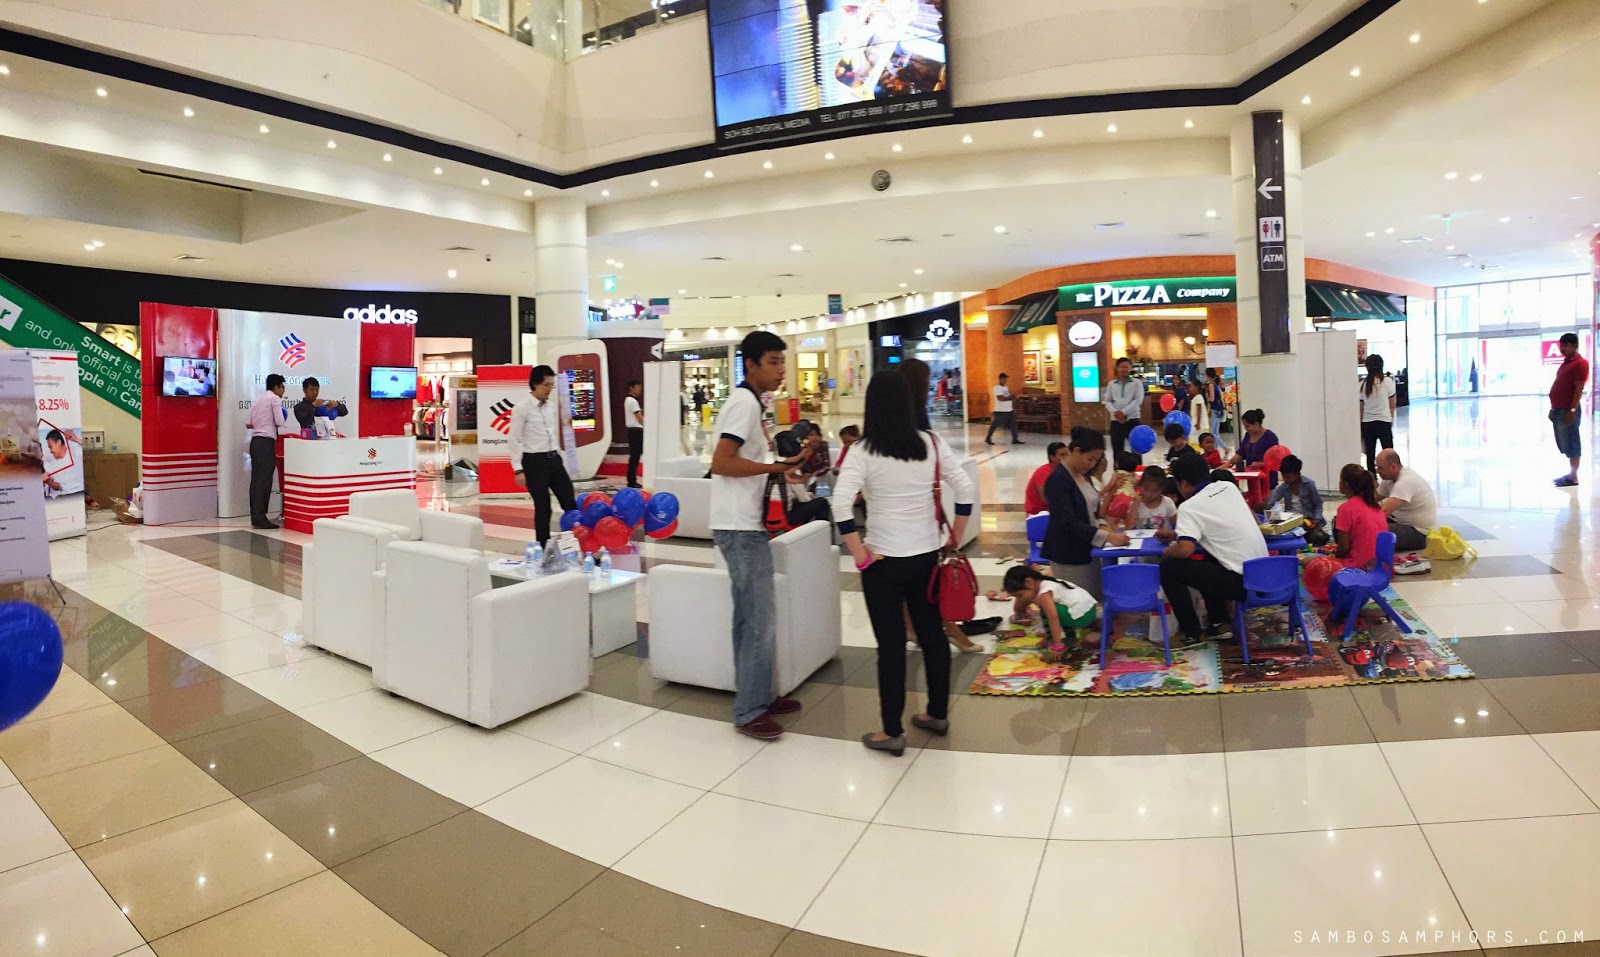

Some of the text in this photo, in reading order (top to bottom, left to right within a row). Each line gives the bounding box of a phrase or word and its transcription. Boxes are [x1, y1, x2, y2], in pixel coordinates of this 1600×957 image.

[755, 122, 784, 134] DIGITAL
[784, 118, 811, 129] MEDIA
[1263, 253, 1284, 263] ATM
[1093, 285, 1171, 307] PIZZA
[1176, 288, 1230, 298] Company
[343, 304, 418, 324] adidas
[25, 320, 142, 396] and onl official ope
[81, 335, 122, 367] Smart
[122, 360, 133, 374] is
[106, 383, 118, 396] in
[38, 398, 70, 411] 8.25%
[482, 438, 509, 446] HongLeo
